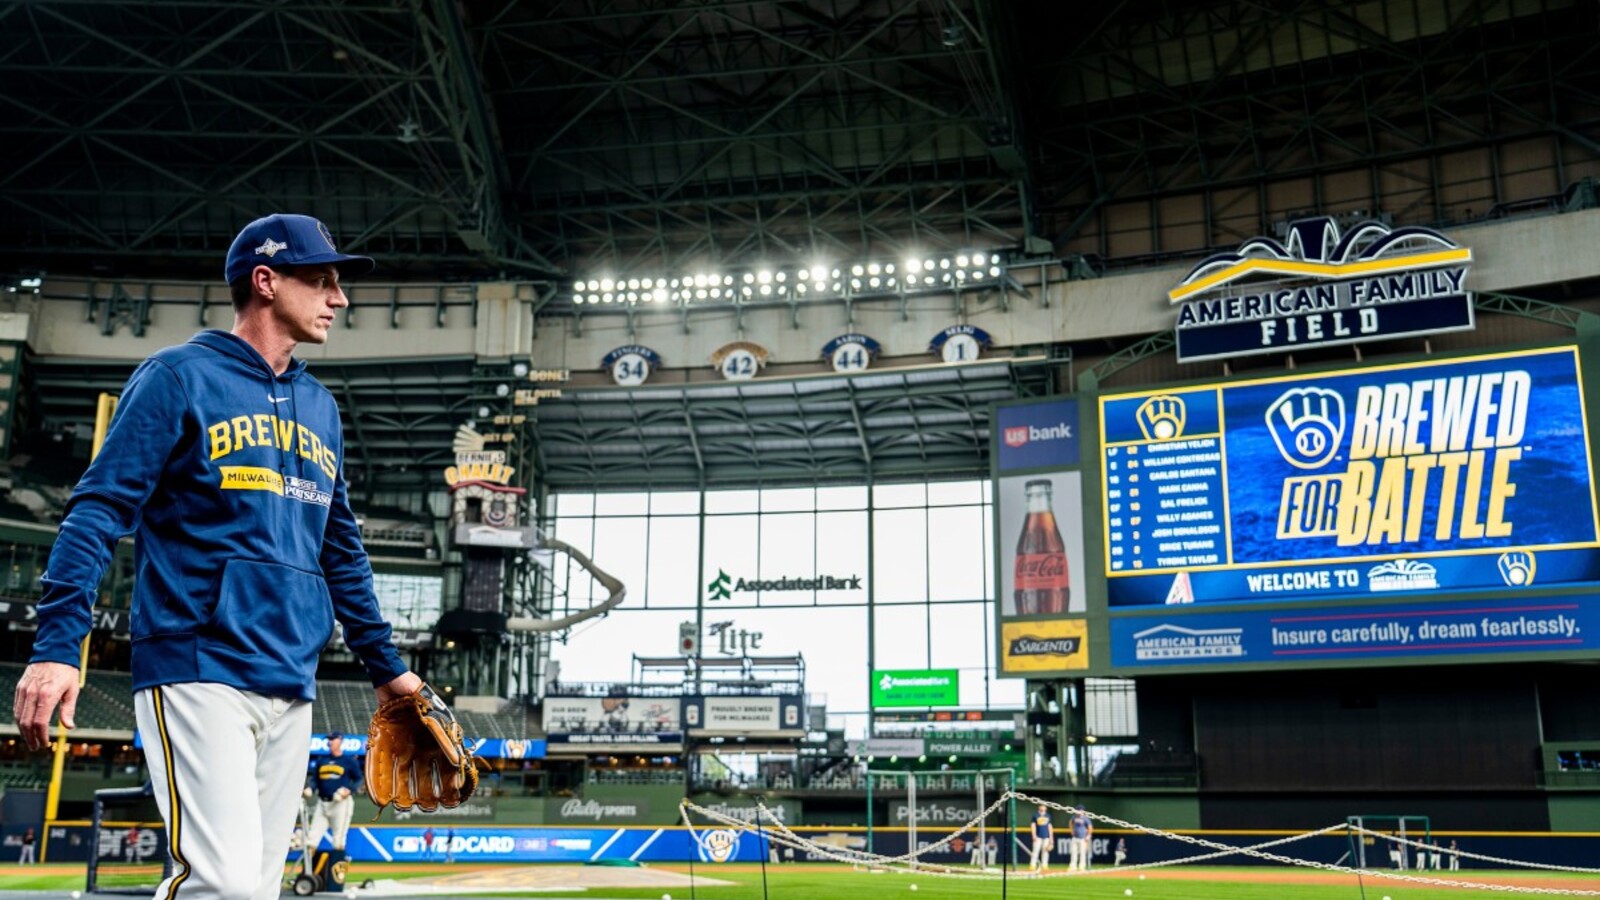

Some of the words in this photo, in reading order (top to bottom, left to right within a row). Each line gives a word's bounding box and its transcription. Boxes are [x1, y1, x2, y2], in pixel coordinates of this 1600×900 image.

[1178, 284, 1338, 327] AMERICAN
[1350, 267, 1469, 306] FAMILY
[1261, 308, 1379, 345] FIELD
[837, 351, 864, 368] 44
[956, 343, 965, 360] 1
[618, 361, 644, 379] 34
[726, 356, 752, 375] 42
[1349, 370, 1532, 460] BREWED
[1029, 422, 1072, 441] bank
[208, 414, 337, 481] BREWERS
[445, 464, 515, 485] CHALET
[1282, 478, 1342, 535] FOR
[1337, 447, 1522, 547] BATTLE
[734, 575, 824, 592] Associated
[825, 574, 862, 590] Bank
[1247, 570, 1331, 592] WELCOME
[1334, 569, 1359, 588] TO
[718, 620, 763, 655] Lite
[1272, 627, 1328, 646] Insure
[1331, 621, 1414, 644] carefully,
[1418, 621, 1477, 640] dream
[1480, 614, 1581, 638] fearlessly.
[1014, 639, 1074, 654] SARGENTO
[1136, 637, 1196, 649] AMERICAN
[1199, 635, 1241, 646] FAMILY
[1144, 648, 1234, 657] INSURANCE
[930, 744, 961, 752] POWER
[963, 744, 992, 752] ALLEY
[561, 799, 604, 821] Bally
[605, 805, 637, 816] SPORTS
